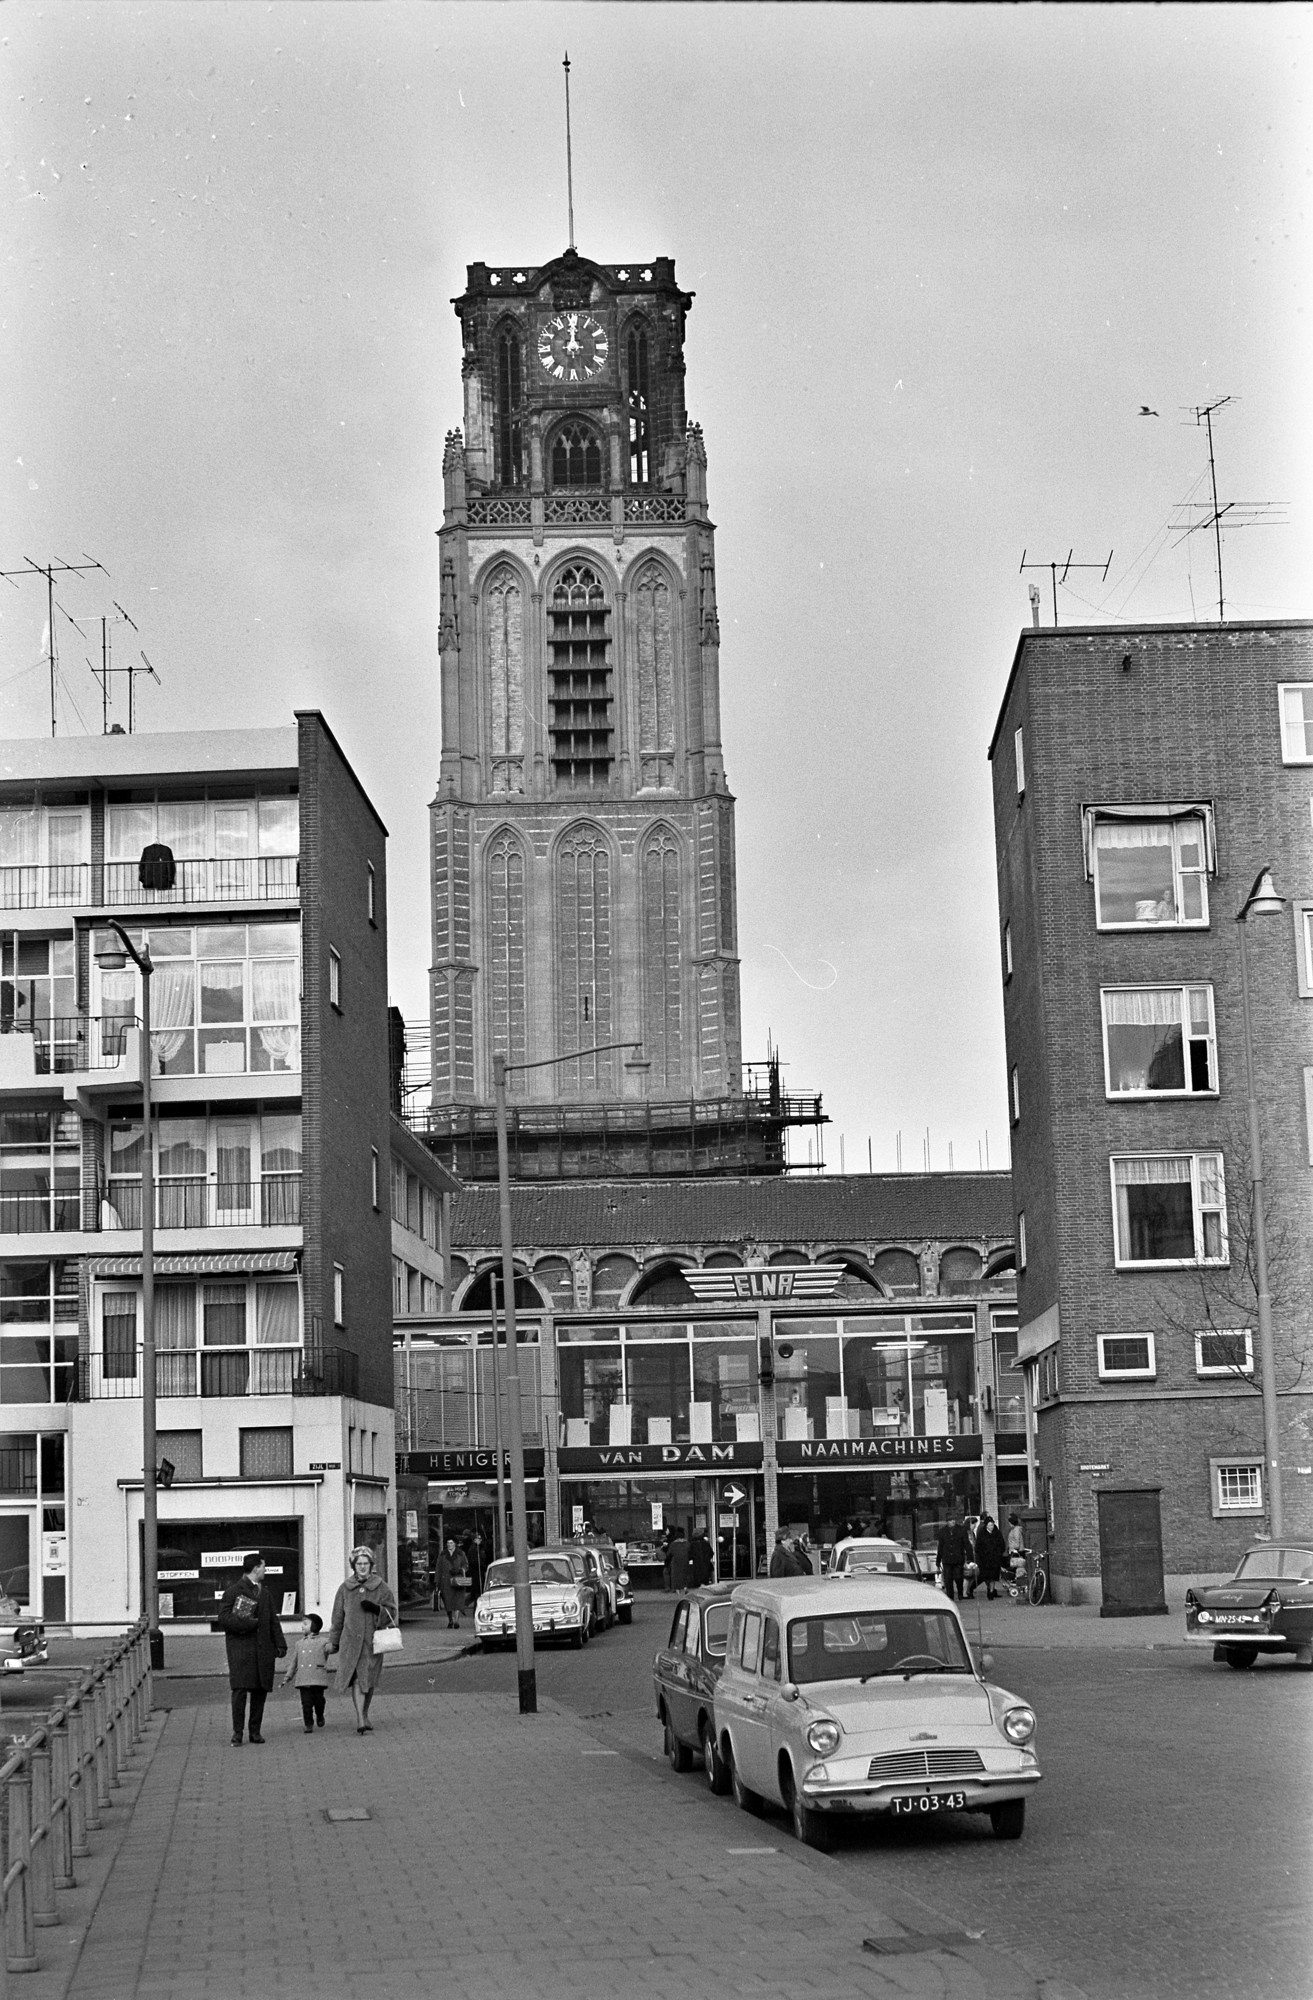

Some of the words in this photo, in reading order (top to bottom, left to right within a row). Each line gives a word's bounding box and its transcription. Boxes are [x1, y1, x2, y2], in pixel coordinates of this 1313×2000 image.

[734, 1273, 794, 1297] ELNA
[599, 1451, 642, 1464] VAN
[661, 1444, 735, 1462] DAM
[801, 1438, 955, 1457] NAAIMACHINES
